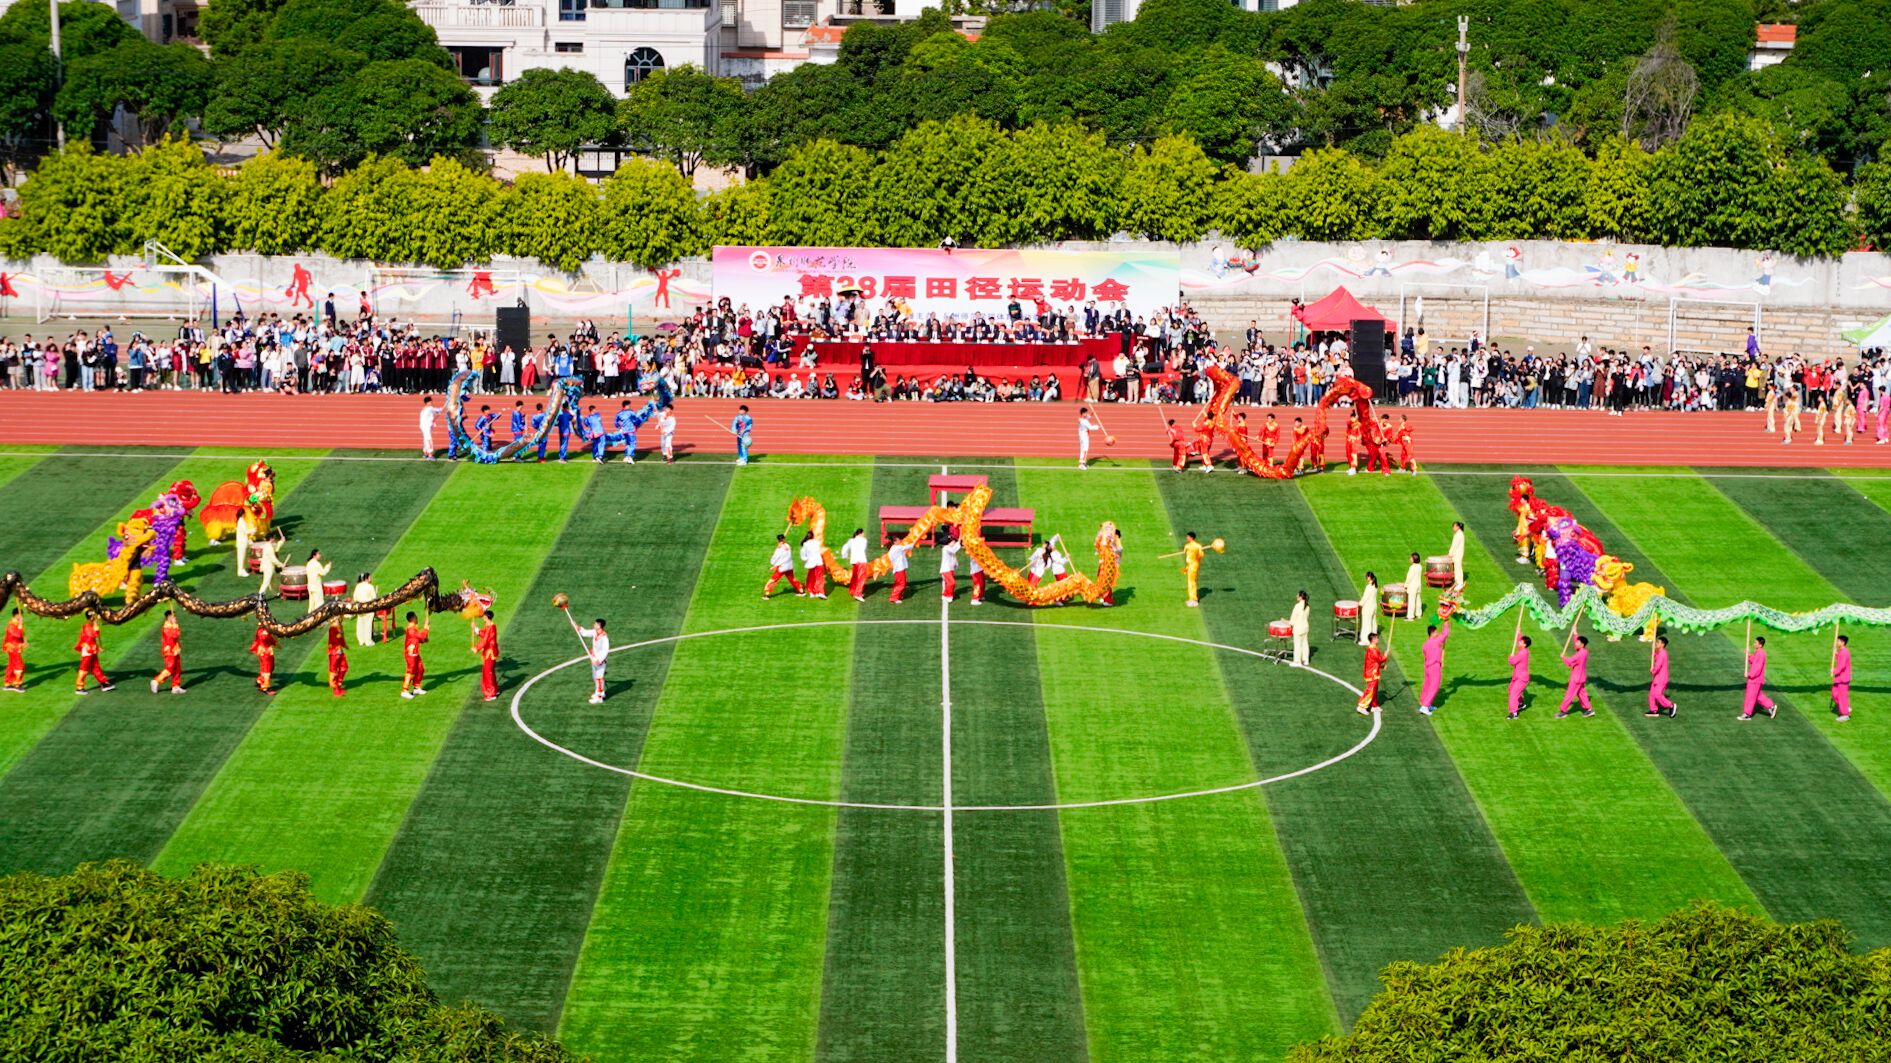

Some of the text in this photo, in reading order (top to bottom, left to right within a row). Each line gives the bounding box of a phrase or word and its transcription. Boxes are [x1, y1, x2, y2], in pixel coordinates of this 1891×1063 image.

[797, 274, 1130, 302] 第28届田径运动会
